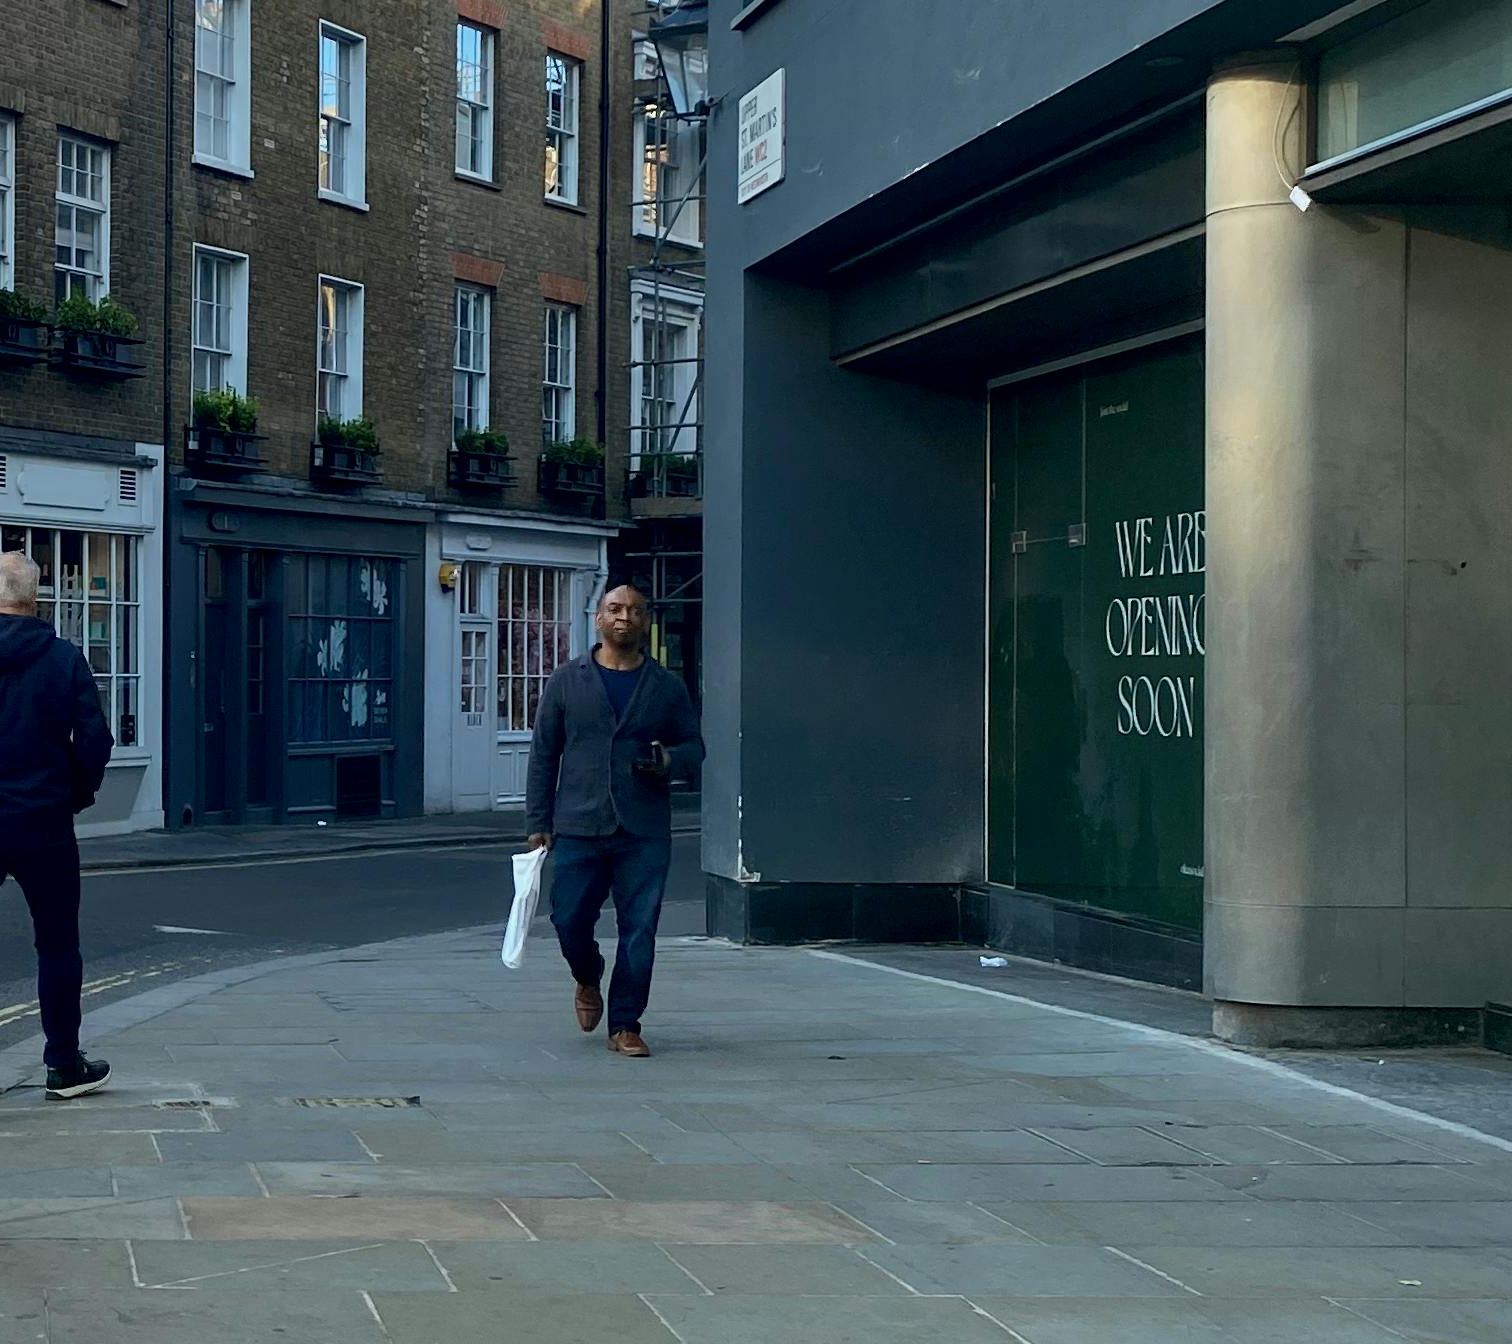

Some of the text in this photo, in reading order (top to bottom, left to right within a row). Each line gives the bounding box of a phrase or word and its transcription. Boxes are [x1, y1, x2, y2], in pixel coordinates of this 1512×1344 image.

[1115, 510, 1206, 577] WE ARE
[1117, 675, 1195, 738] SOON
